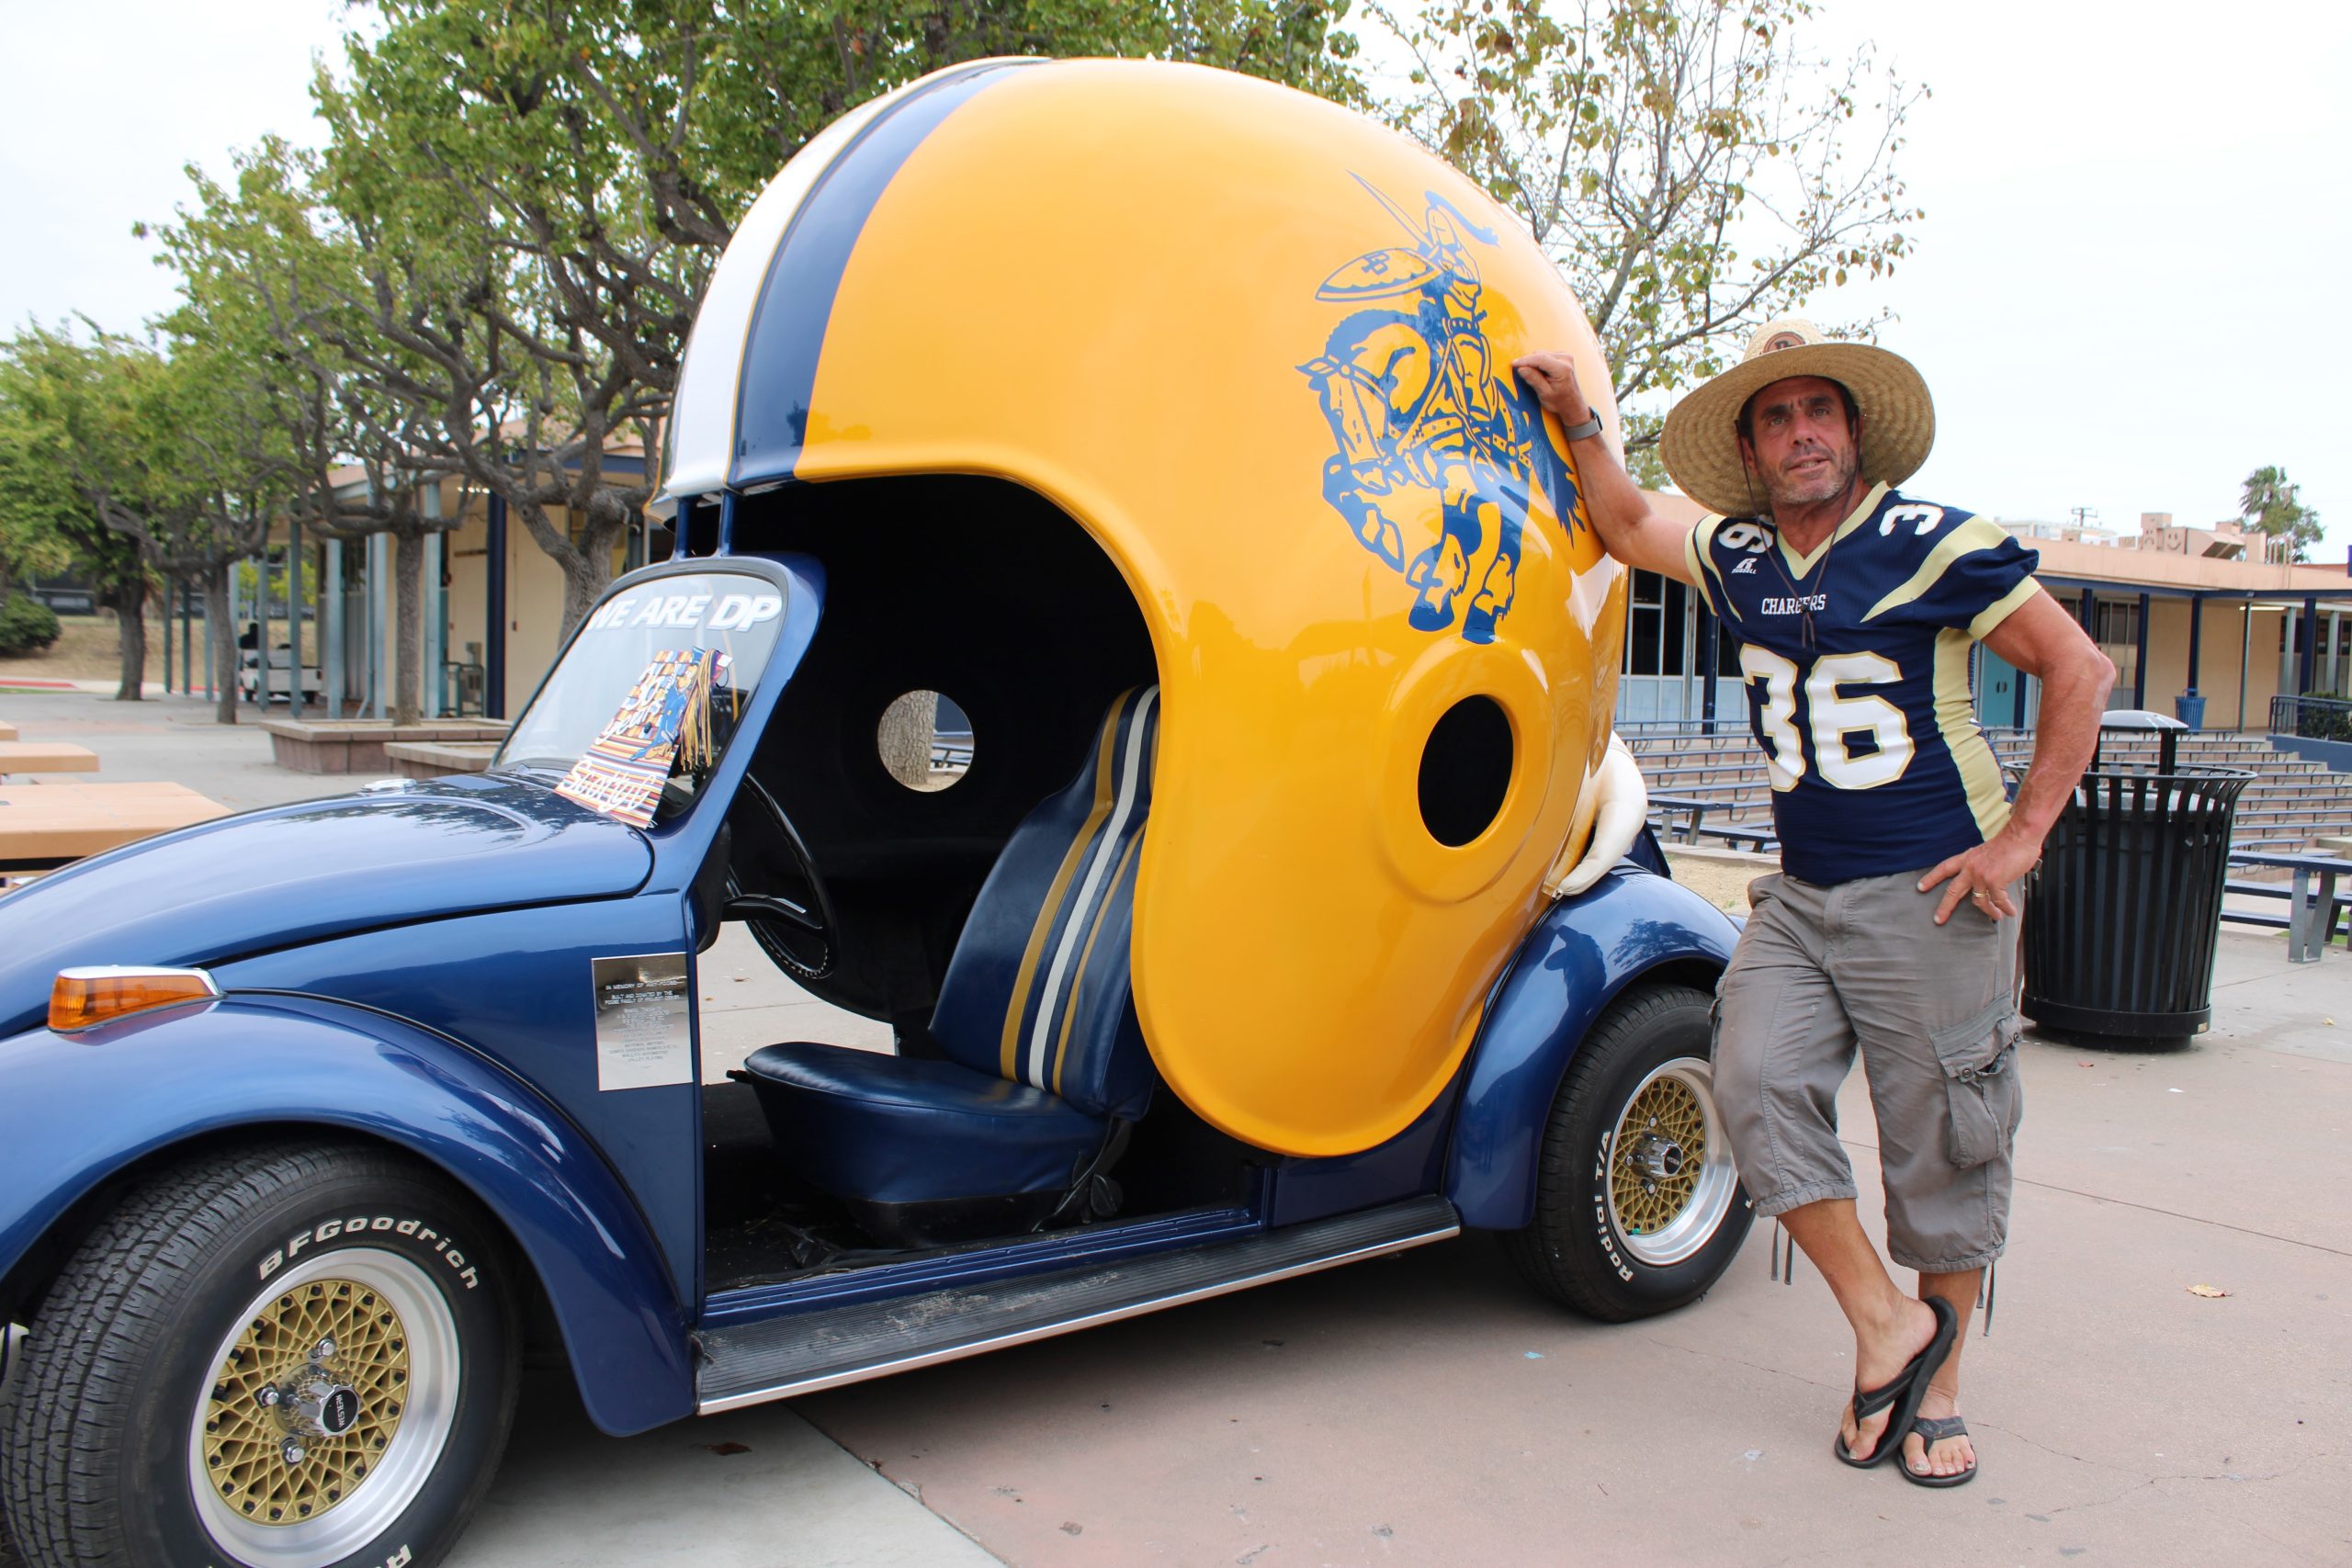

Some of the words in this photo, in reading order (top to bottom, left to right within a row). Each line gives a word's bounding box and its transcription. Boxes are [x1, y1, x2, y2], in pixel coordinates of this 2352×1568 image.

[630, 594, 715, 631] ARE
[707, 593, 783, 633] DP
[594, 700, 662, 745] years
[1739, 642, 1916, 794] 36
[1594, 1131, 1611, 1182] T/A
[1594, 1195, 1634, 1283] Radial
